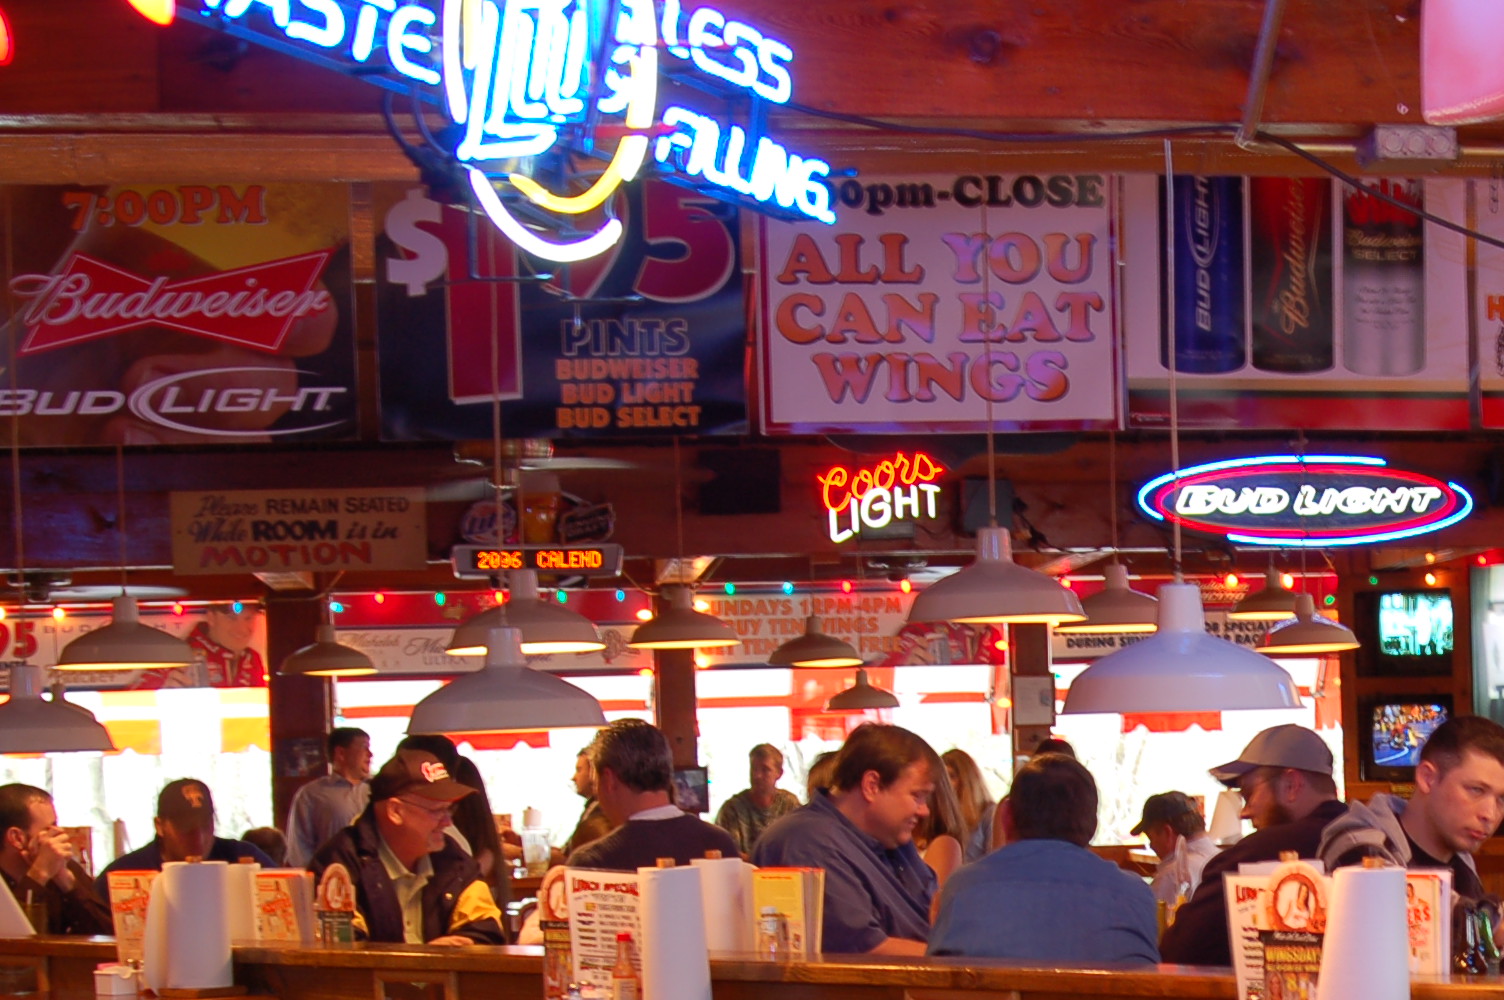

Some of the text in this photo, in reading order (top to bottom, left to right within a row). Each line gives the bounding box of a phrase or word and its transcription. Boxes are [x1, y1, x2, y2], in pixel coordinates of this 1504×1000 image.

[63, 185, 268, 232] 7:00PM
[776, 231, 1098, 285] ALL YOU
[9, 272, 330, 326] Budweiser
[1194, 268, 1213, 332] BUD
[775, 291, 1106, 345] CAN EAT
[560, 319, 692, 357] PINTS
[555, 358, 700, 381] BUDWEISER
[811, 350, 1072, 404] WINGS
[0, 386, 348, 416] BUD LIGHT
[561, 381, 694, 404] BUD LIGHT
[556, 406, 702, 428] BUD SELECT
[816, 452, 944, 513] Coors
[265, 498, 338, 516] REMAIN
[345, 496, 411, 514] SEATED
[829, 483, 941, 544] LIGHT
[1175, 484, 1442, 516] BUD LIGHT
[252, 519, 338, 542] ROOM
[345, 521, 367, 540] is
[371, 520, 398, 540] in
[200, 542, 373, 568] MOTION
[706, 598, 793, 616] UNDAYS
[1066, 636, 1116, 649] DURING
[1223, 621, 1272, 635] SPECIAL
